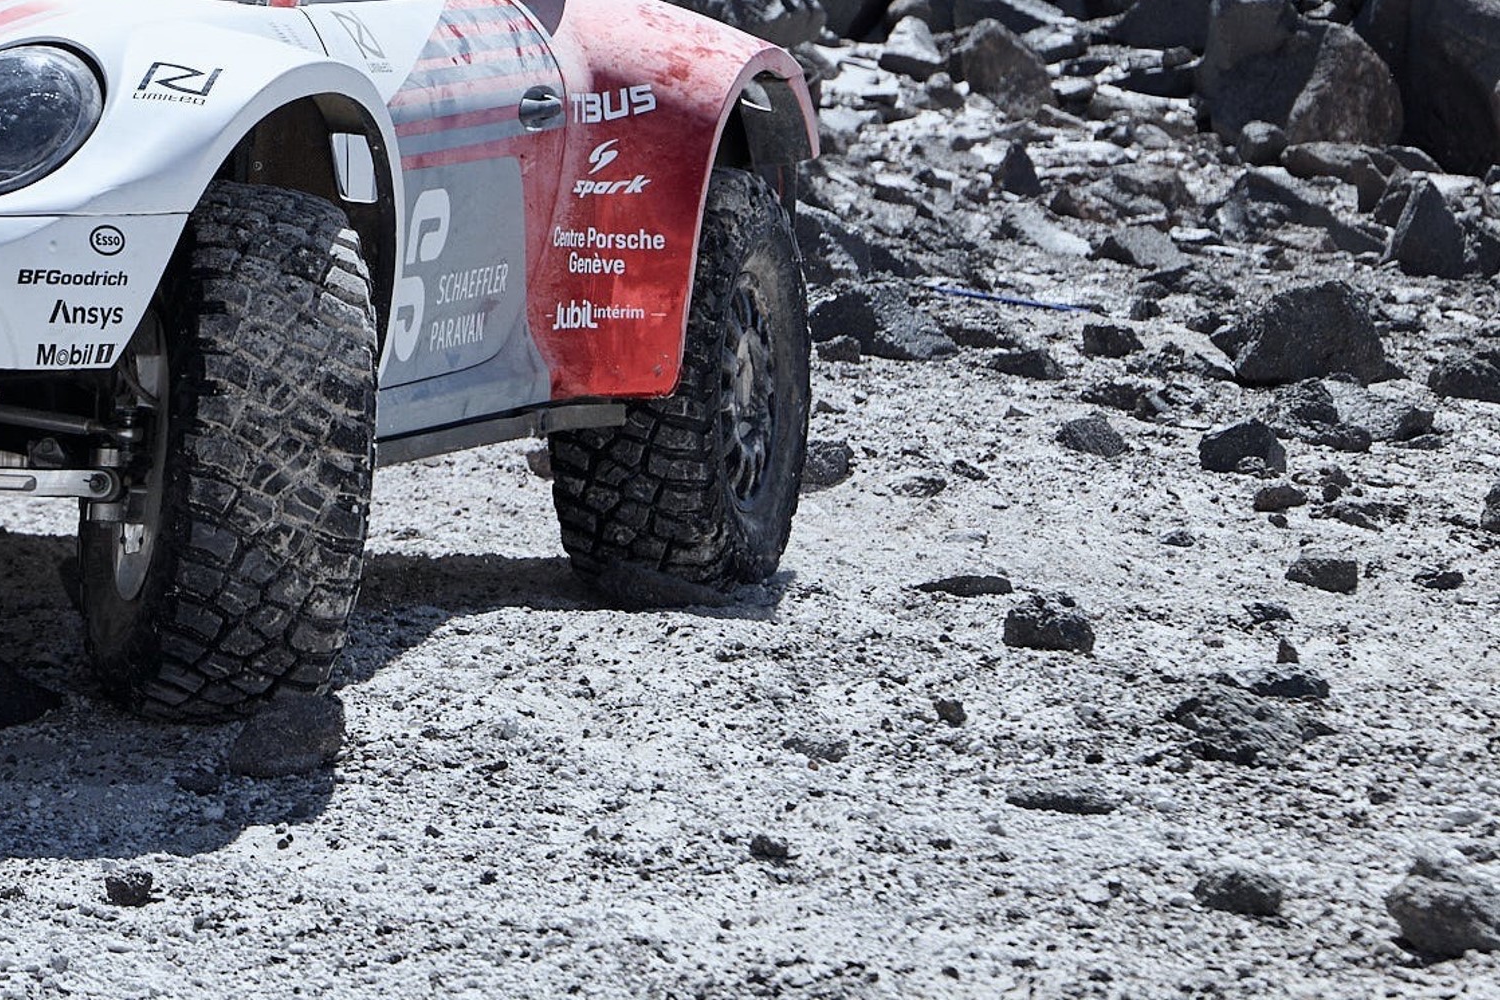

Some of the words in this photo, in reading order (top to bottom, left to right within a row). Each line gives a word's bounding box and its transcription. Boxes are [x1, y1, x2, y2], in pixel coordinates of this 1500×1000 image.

[572, 174, 652, 198] spark
[95, 233, 120, 246] Esso
[553, 226, 586, 249] Centre
[587, 227, 666, 250] Porsche
[569, 251, 626, 275] Genève
[17, 269, 128, 286] BFGoodrich
[436, 262, 509, 305] SCHAEFFLER
[49, 300, 124, 330] Ansys
[429, 312, 485, 353] PARAVAN
[36, 344, 94, 366] Mobil
